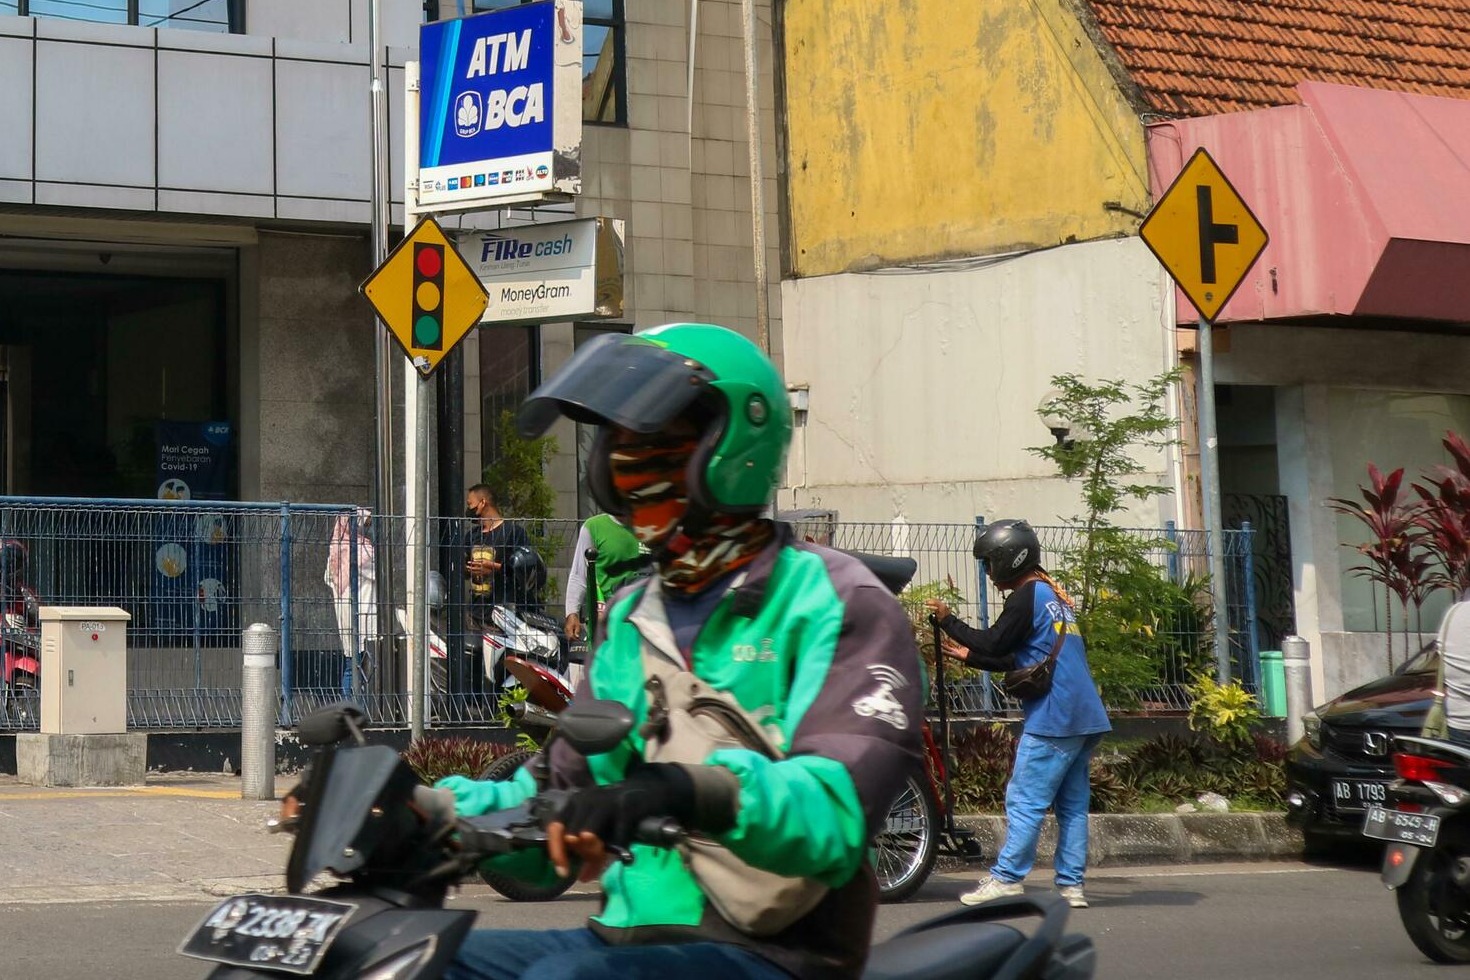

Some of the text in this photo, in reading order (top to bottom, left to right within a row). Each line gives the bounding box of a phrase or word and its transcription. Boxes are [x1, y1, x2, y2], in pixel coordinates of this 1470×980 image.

[466, 28, 532, 79] ATM
[484, 82, 544, 130] BCA
[534, 233, 572, 257] cash
[501, 284, 570, 303] MoneyGram
[162, 445, 209, 456] Mari Cegah
[162, 454, 211, 464] Penyebaran
[161, 463, 198, 471] Covid-19
[1336, 782, 1386, 801] AB 1793
[1370, 810, 1386, 823] AB
